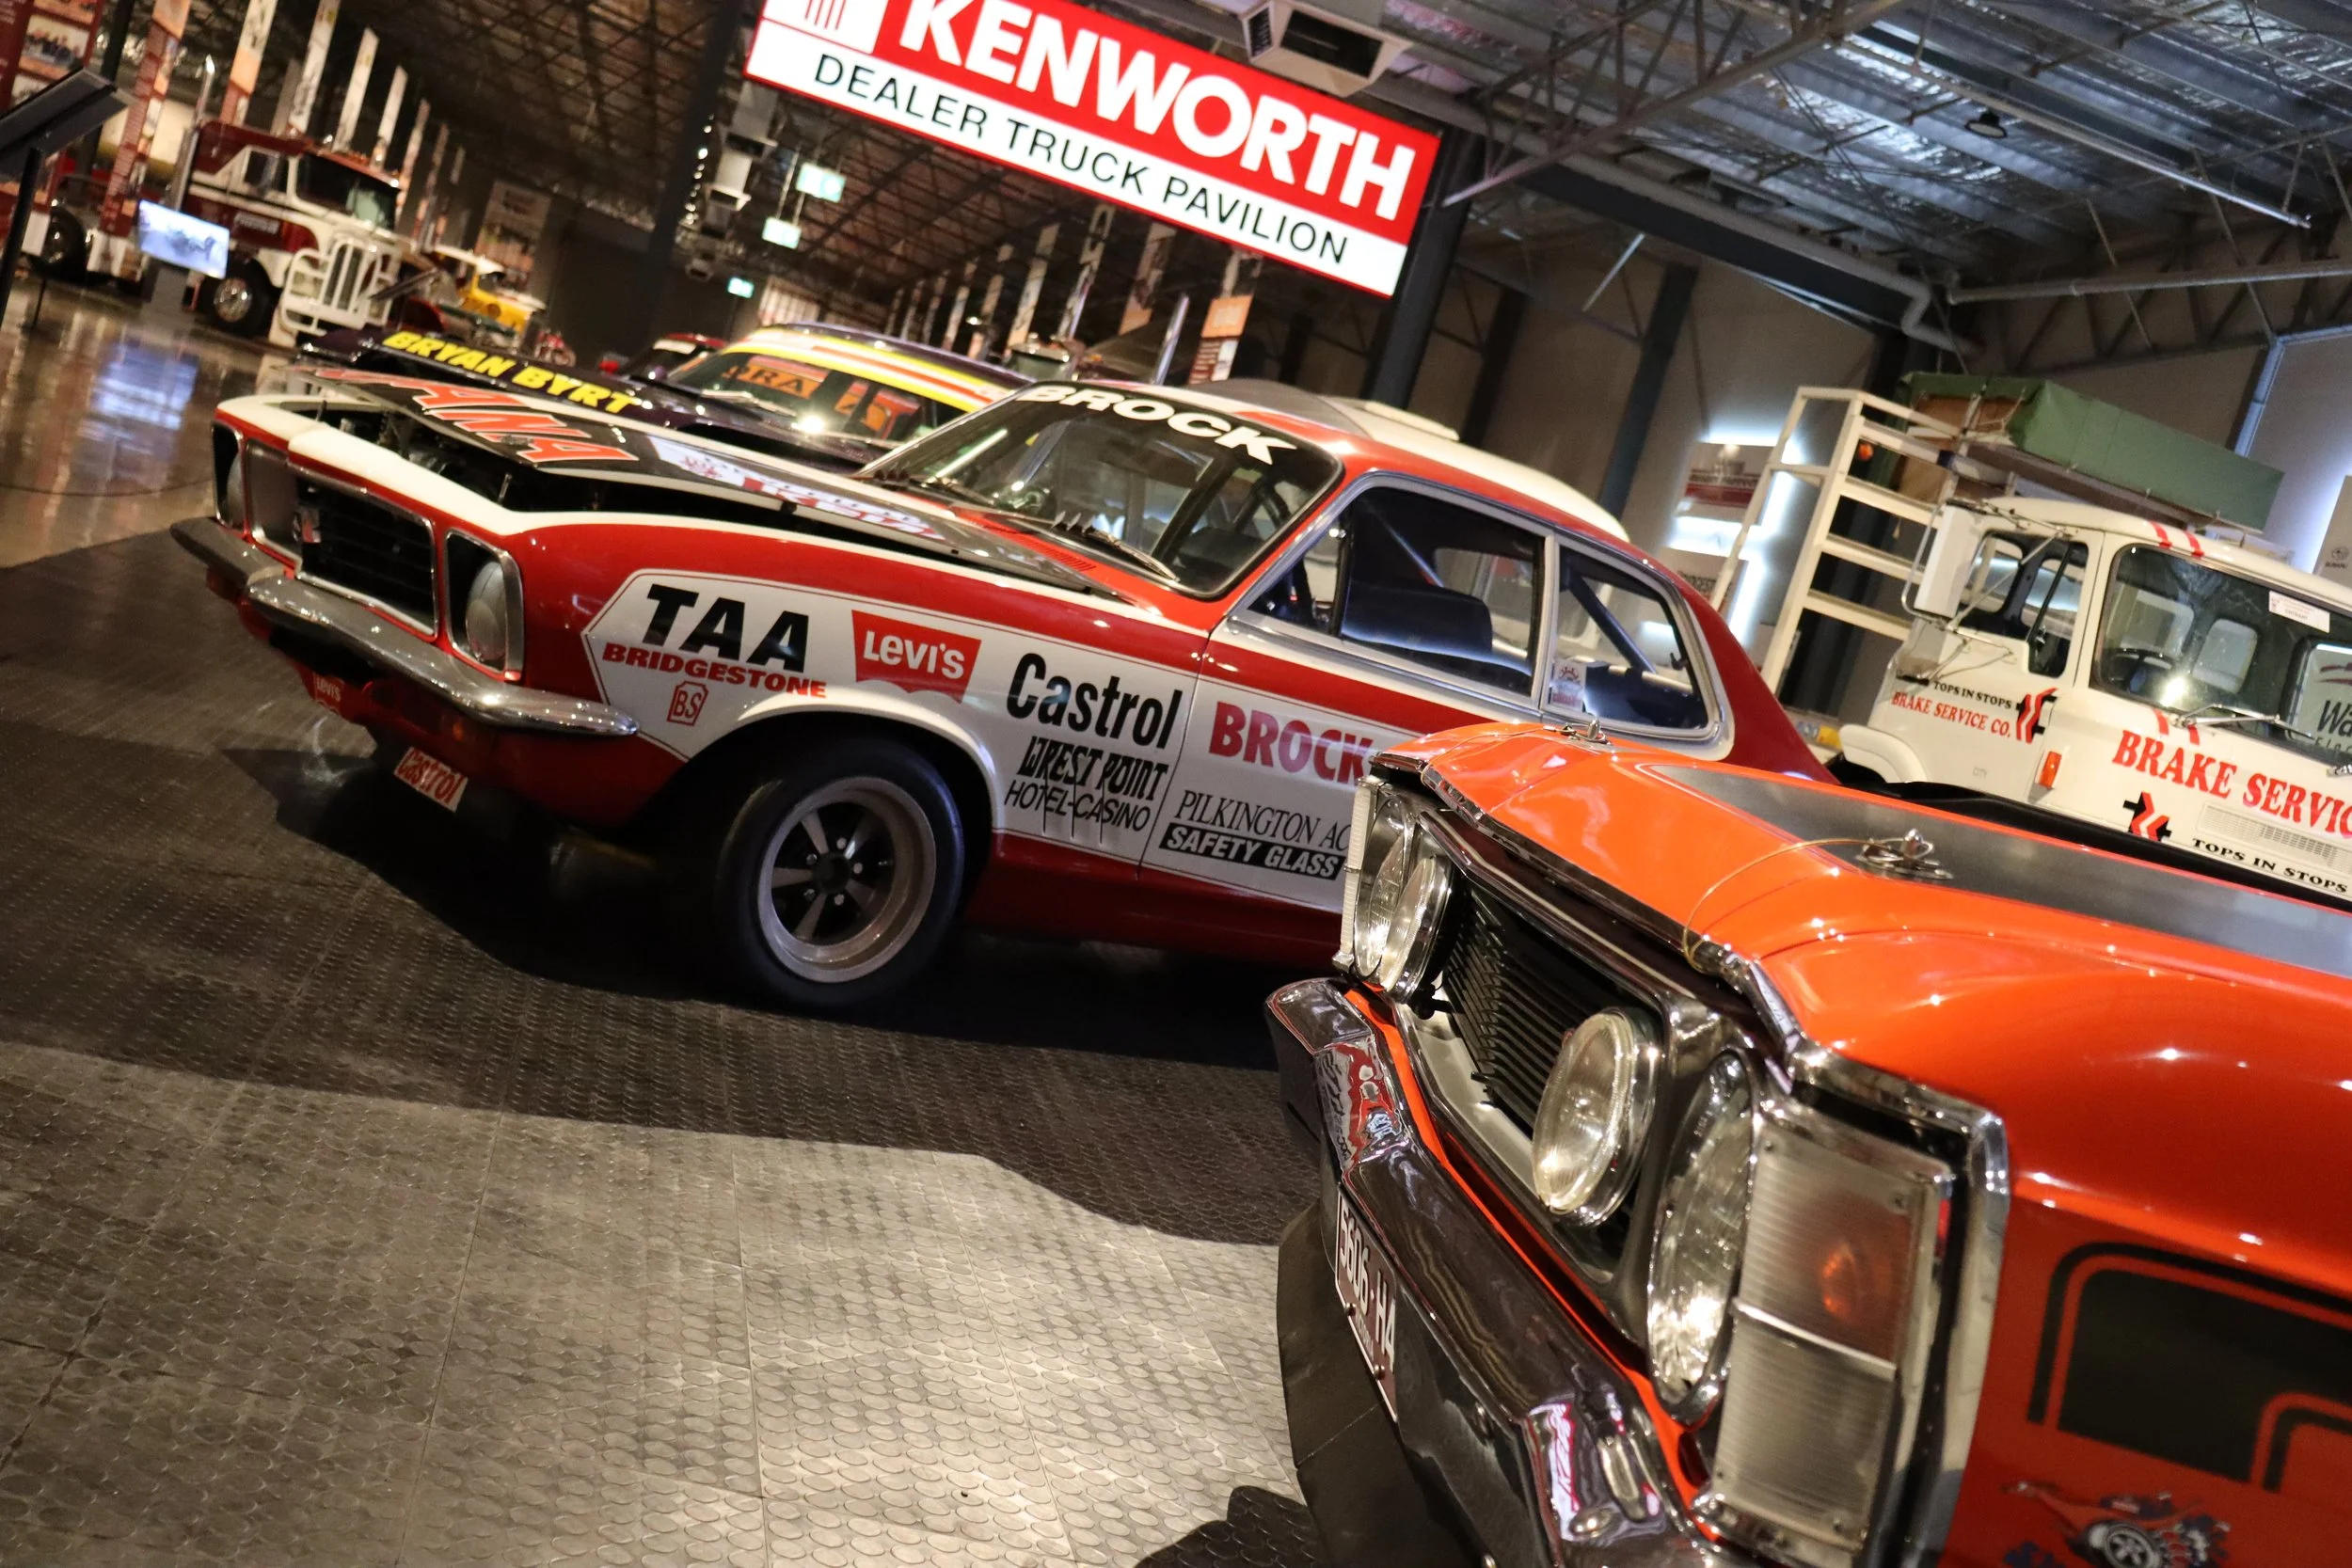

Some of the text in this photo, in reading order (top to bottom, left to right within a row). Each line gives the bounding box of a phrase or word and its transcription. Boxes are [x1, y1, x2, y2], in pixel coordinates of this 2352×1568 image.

[898, 0, 1415, 221] KENWORTH
[814, 53, 1348, 264] DEALER TRUCK PAVILION
[382, 330, 637, 414] BRYAN BYRT
[1016, 385, 1297, 465] BROCK
[642, 582, 810, 673] TAA
[602, 641, 828, 700] BRIDGESTONE
[1006, 652, 1184, 750] Castrol
[1933, 679, 2012, 710] TOPS IN STOPS
[673, 688, 704, 720] BS
[1891, 690, 2012, 738] BRAKE SERVICE CO.
[1016, 735, 1169, 801] WREST POINT
[1208, 700, 1375, 788] BROCK
[2111, 729, 2237, 800] BRAKE
[395, 747, 467, 805] Castrol
[1004, 779, 1152, 832] HOTEL-CASINO
[1174, 788, 1322, 845] PILKINGTON
[1166, 825, 1341, 879] SAFETY GLASS
[2191, 836, 2349, 894] TOPS IN STOPS
